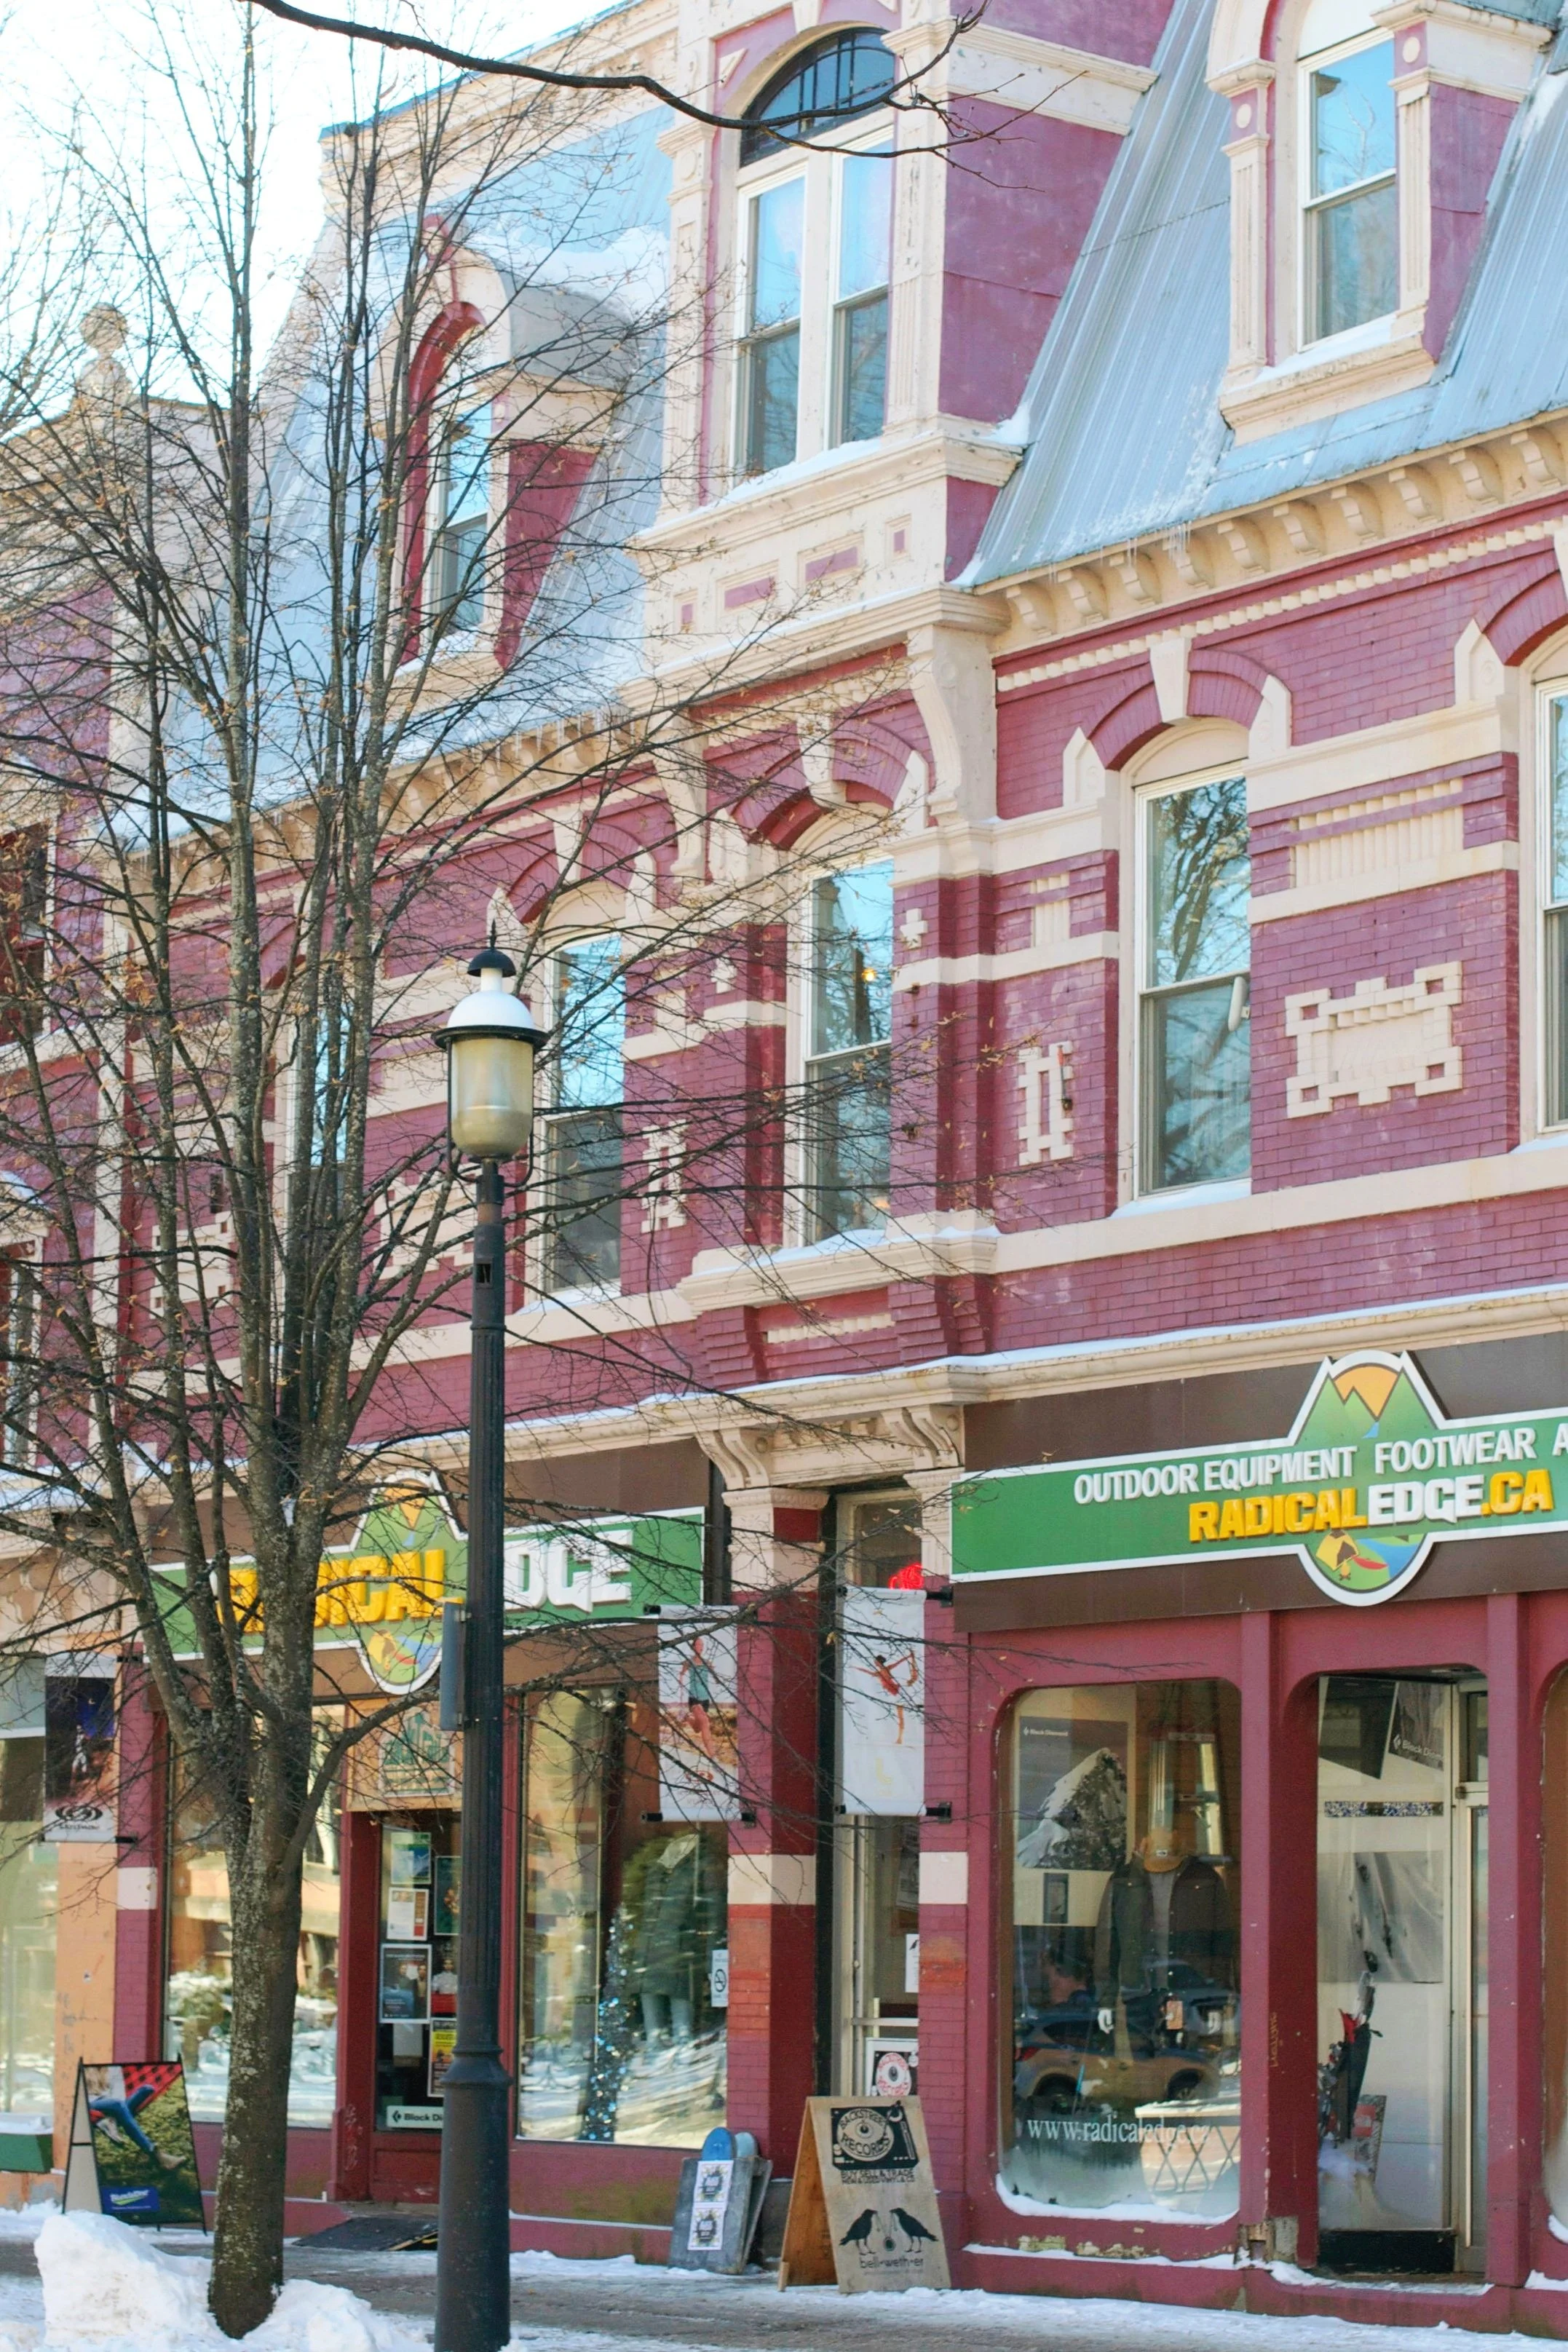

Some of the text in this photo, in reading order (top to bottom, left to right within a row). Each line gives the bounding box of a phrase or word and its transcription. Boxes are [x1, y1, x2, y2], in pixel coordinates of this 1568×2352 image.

[1074, 1462, 1200, 1505] OUTDOOR
[1203, 1446, 1358, 1492] EQUIPMENT
[1374, 1427, 1538, 1475] FOOTWEAR
